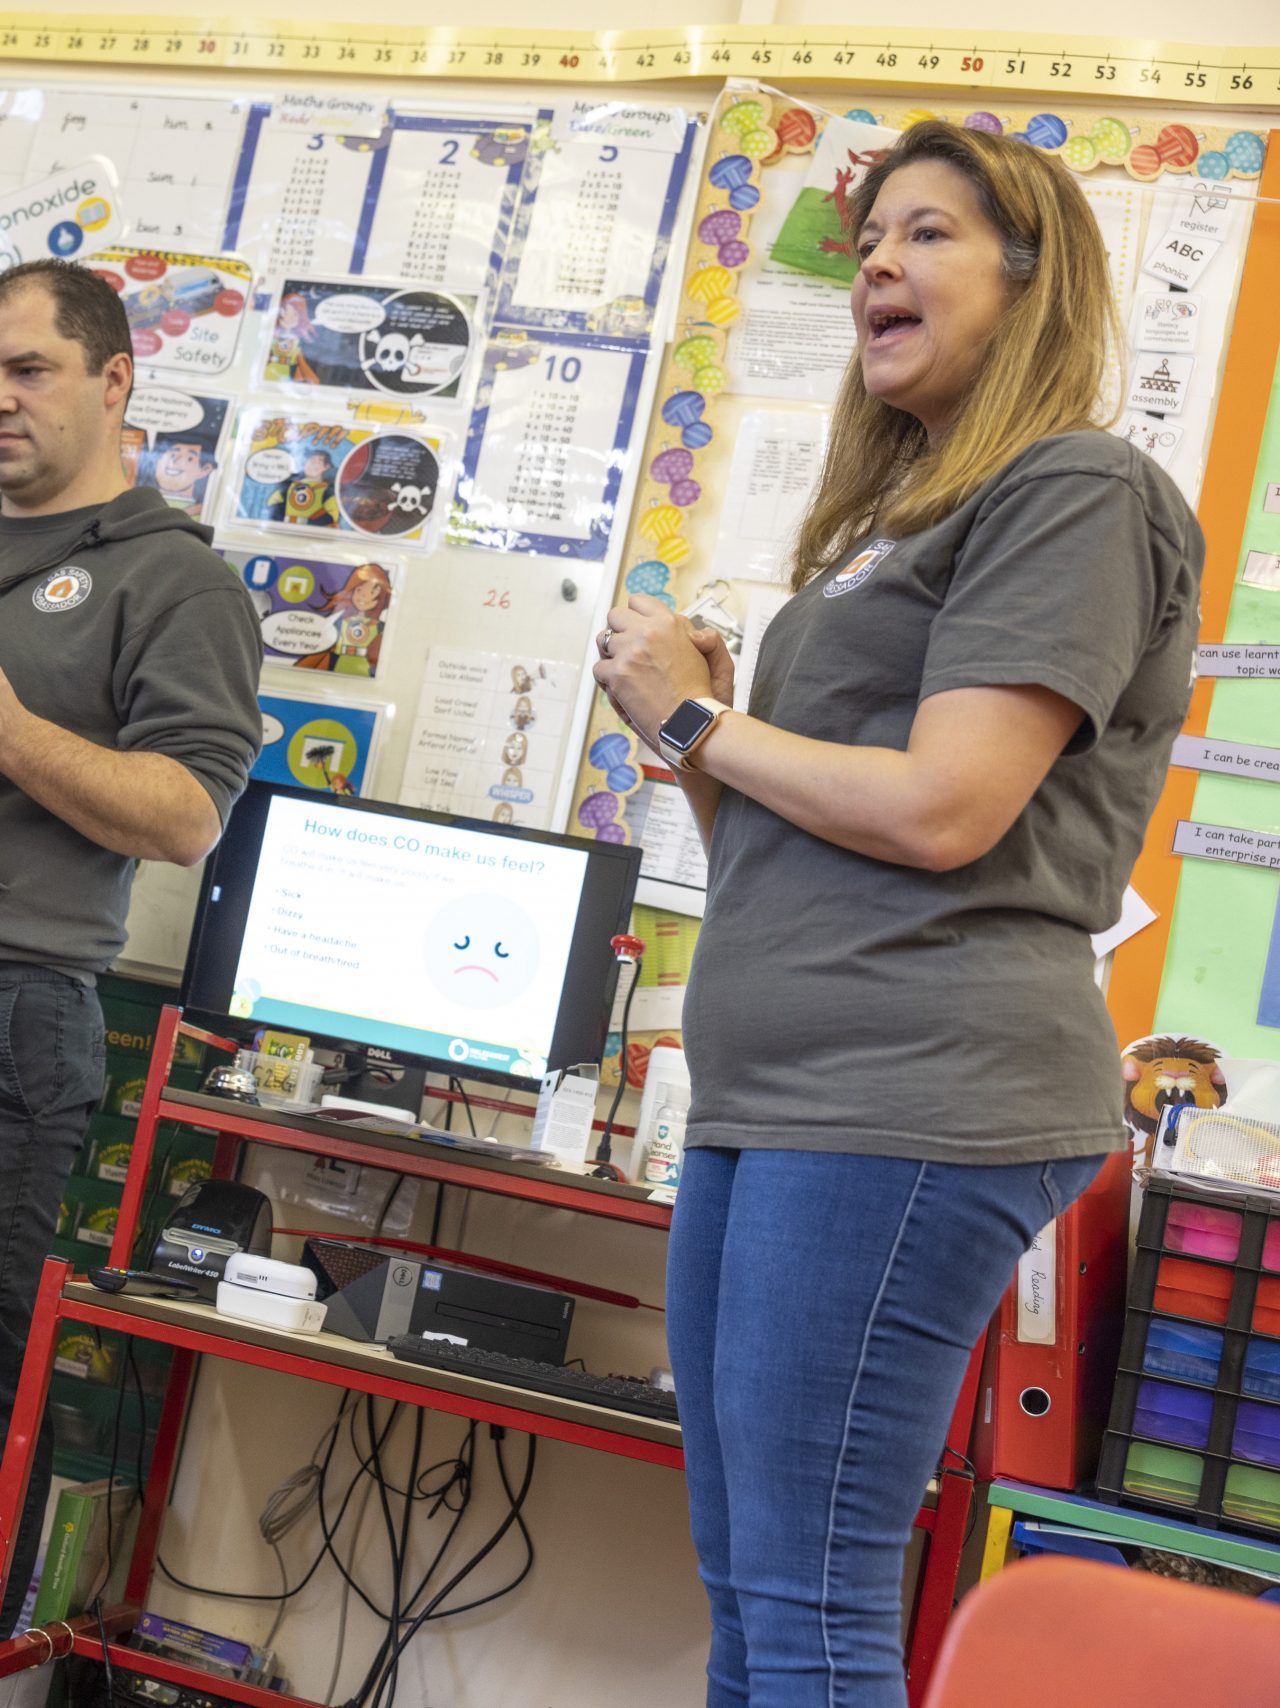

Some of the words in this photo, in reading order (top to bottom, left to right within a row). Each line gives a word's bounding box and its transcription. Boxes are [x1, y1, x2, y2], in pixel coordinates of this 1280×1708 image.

[198, 40, 216, 54] 30
[484, 52, 503, 65] 38
[521, 54, 540, 67] 39
[559, 54, 579, 68] 40
[636, 54, 655, 67] 42
[711, 50, 731, 63] 44
[751, 50, 771, 64] 45
[793, 51, 812, 64] 46
[833, 52, 854, 65] 47
[876, 54, 897, 67] 48
[918, 56, 940, 70] 49
[960, 57, 984, 73] 50
[1005, 60, 1025, 74] 51
[1049, 63, 1071, 77] 52
[1094, 65, 1116, 80] 53
[1184, 73, 1207, 88] 55
[1230, 75, 1253, 90] 56
[439, 140, 459, 165] 2
[1180, 219, 1219, 234] register
[1166, 240, 1204, 263] ABC
[1152, 260, 1189, 282] phonics
[190, 327, 219, 343] Site
[174, 347, 226, 368] Safety
[545, 355, 582, 383] 10
[1131, 393, 1180, 409] assembly
[483, 589, 512, 609] 26
[288, 613, 315, 624] Check
[276, 625, 322, 638] Appliances
[272, 638, 296, 650] Every
[1199, 650, 1219, 658] can
[1221, 649, 1241, 659] use
[1244, 648, 1279, 660] learnt
[1236, 664, 1266, 677] topic
[1203, 750, 1209, 760] I
[1213, 753, 1235, 763] can
[1237, 755, 1251, 766] be
[1195, 827, 1202, 837] I
[1205, 829, 1226, 839] can
[1229, 831, 1254, 846] take
[304, 819, 341, 839] How
[347, 827, 387, 848] does
[393, 835, 421, 853] CO
[425, 840, 471, 862] make
[477, 852, 496, 866] us
[502, 854, 547, 876] feel?
[1205, 844, 1267, 863] enterprise
[281, 888, 302, 900] Sick
[277, 906, 303, 920] Dizzy
[273, 925, 298, 938] Have
[309, 932, 358, 950] headache
[270, 945, 288, 956] Out
[290, 949, 302, 958] of
[303, 950, 360, 970] breath/tired
[368, 1048, 392, 1060] DELL
[192, 1224, 222, 1234] DYMO
[168, 1261, 206, 1276] LabelWriter
[206, 1270, 219, 1278] 450
[1025, 1269, 1047, 1315] Reading
